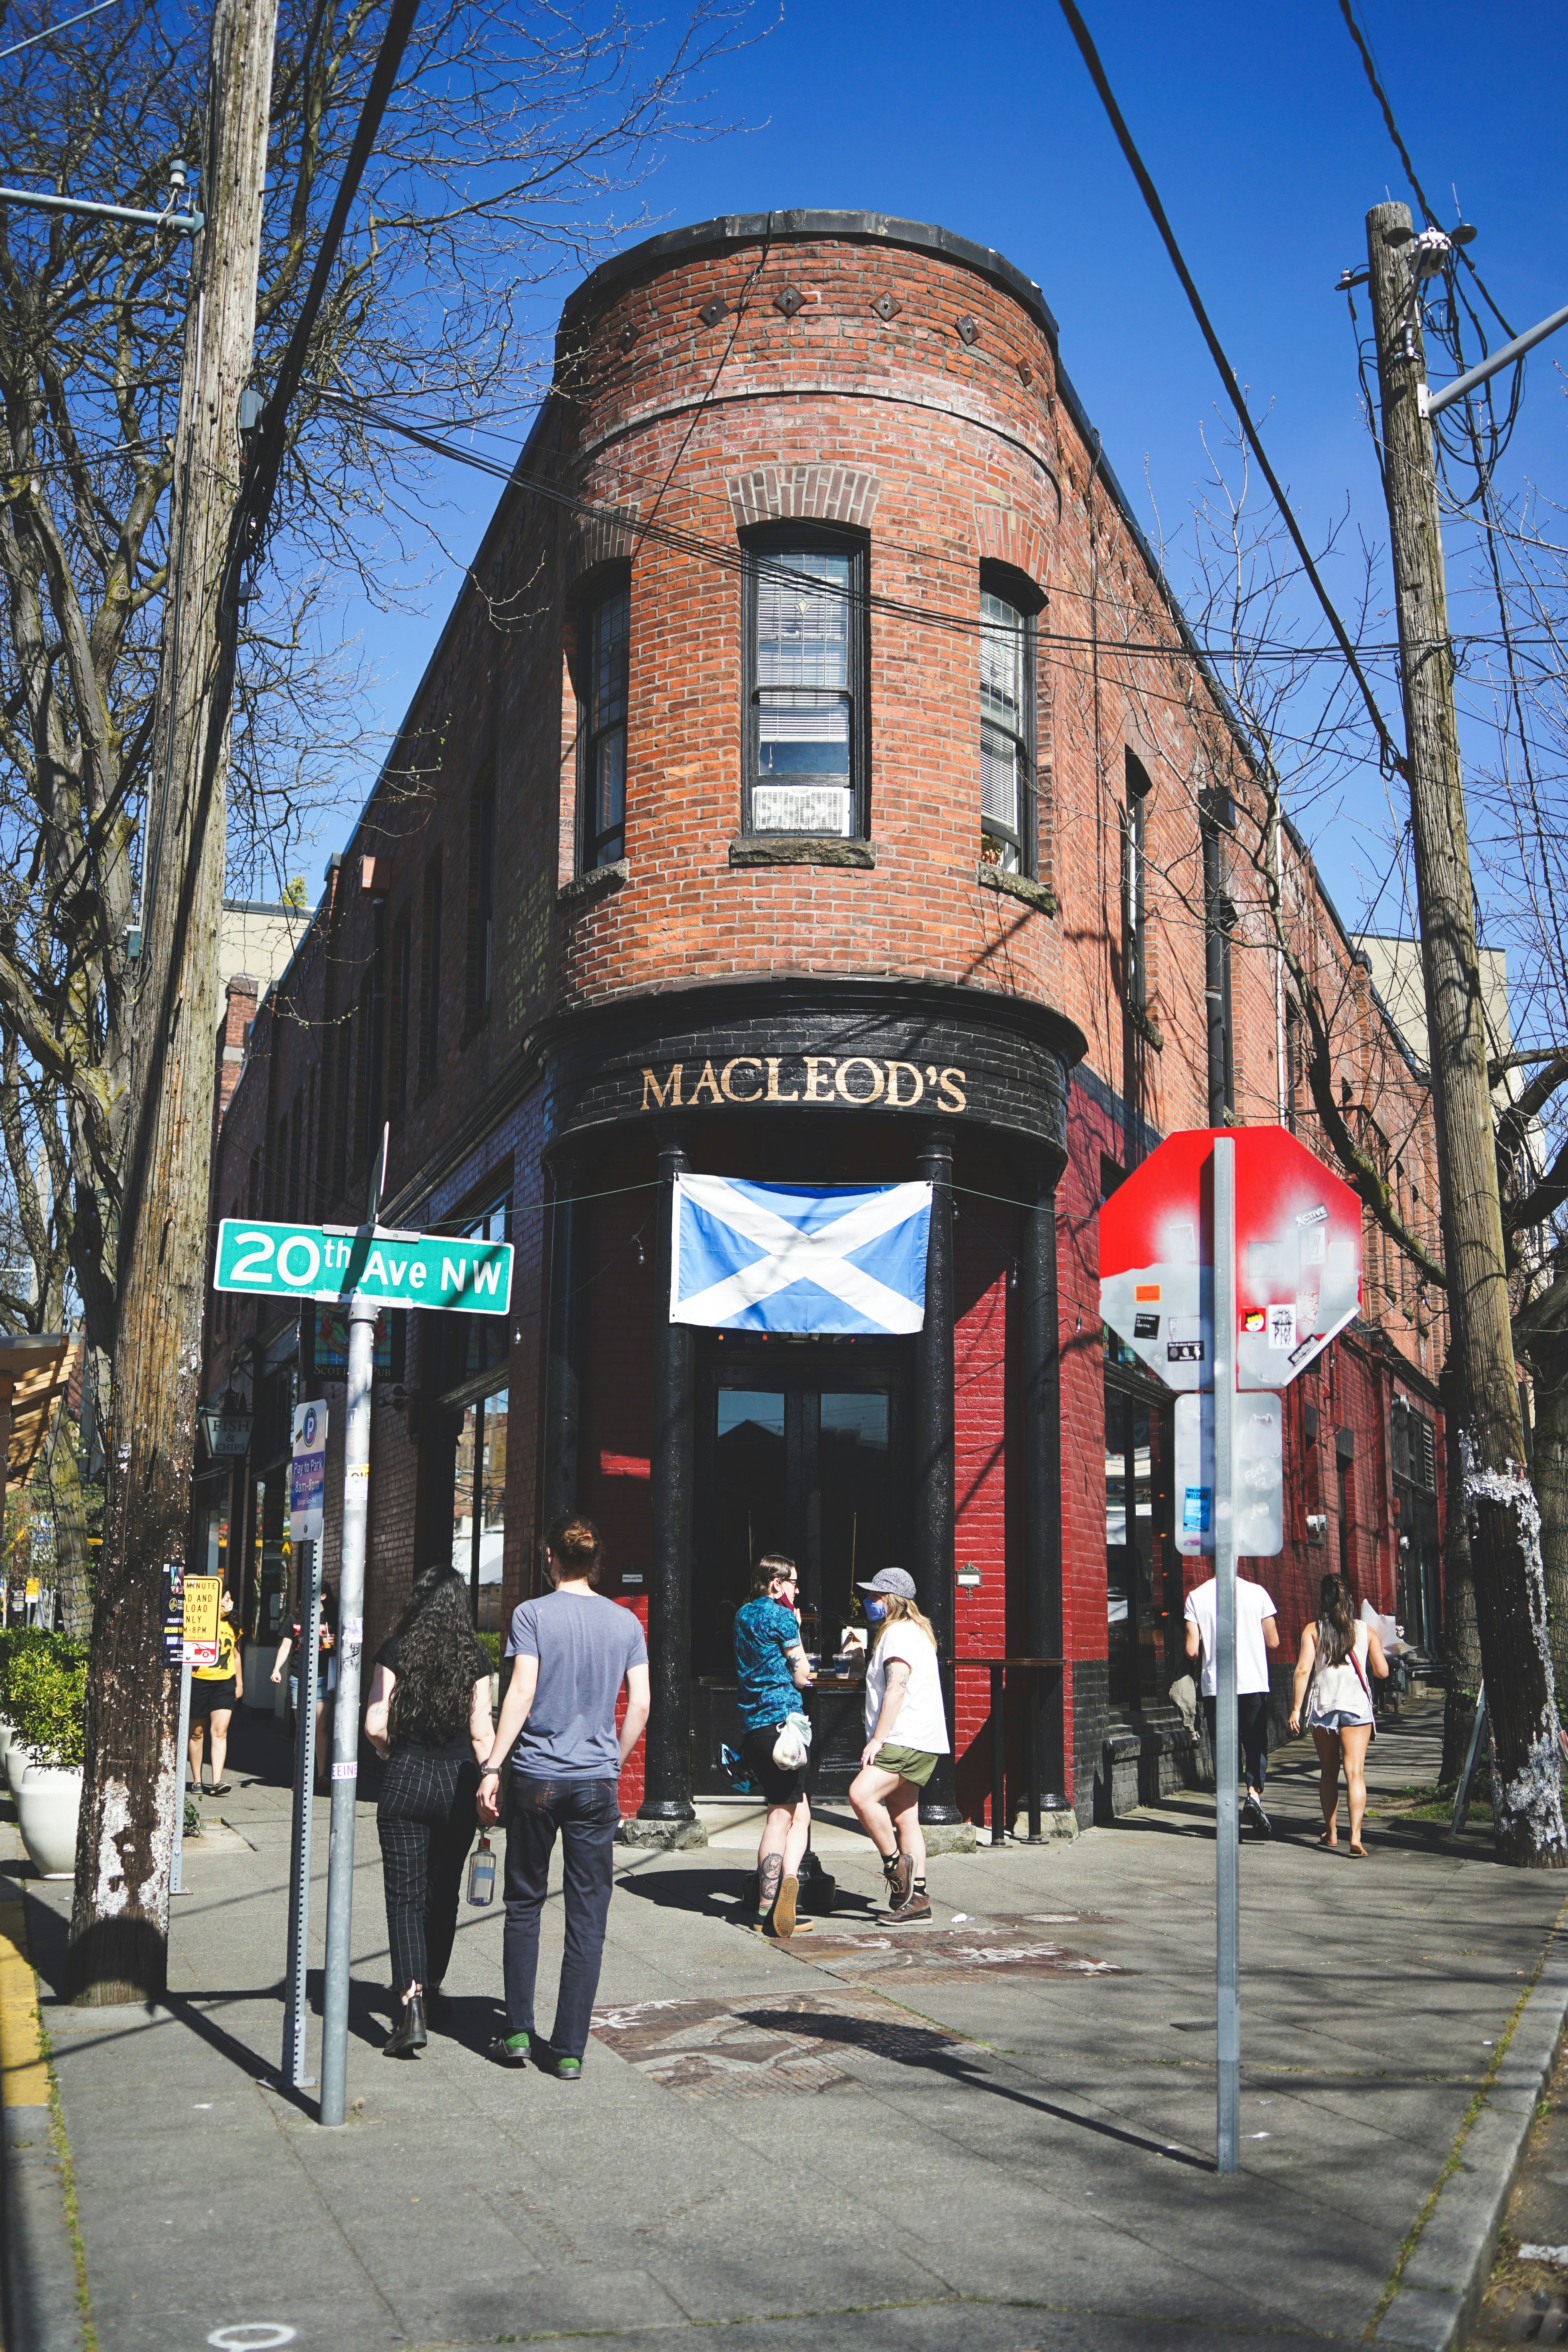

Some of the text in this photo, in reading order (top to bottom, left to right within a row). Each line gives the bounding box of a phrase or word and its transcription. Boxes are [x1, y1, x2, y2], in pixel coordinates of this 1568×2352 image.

[639, 1056, 967, 1112] MACLEOD'S
[1296, 1206, 1327, 1228] ACTIVE
[230, 1232, 502, 1295] 20th Ave NW
[314, 1365, 391, 1376] SCOTT PUB
[212, 1420, 250, 1432] FISH
[226, 1433, 235, 1442] &
[294, 1459, 322, 1477] Pay to Park
[295, 1479, 319, 1494] 8am-8pm
[184, 1594, 192, 1602] AD
[197, 1594, 212, 1602] AND
[186, 1615, 202, 1623] NLY
